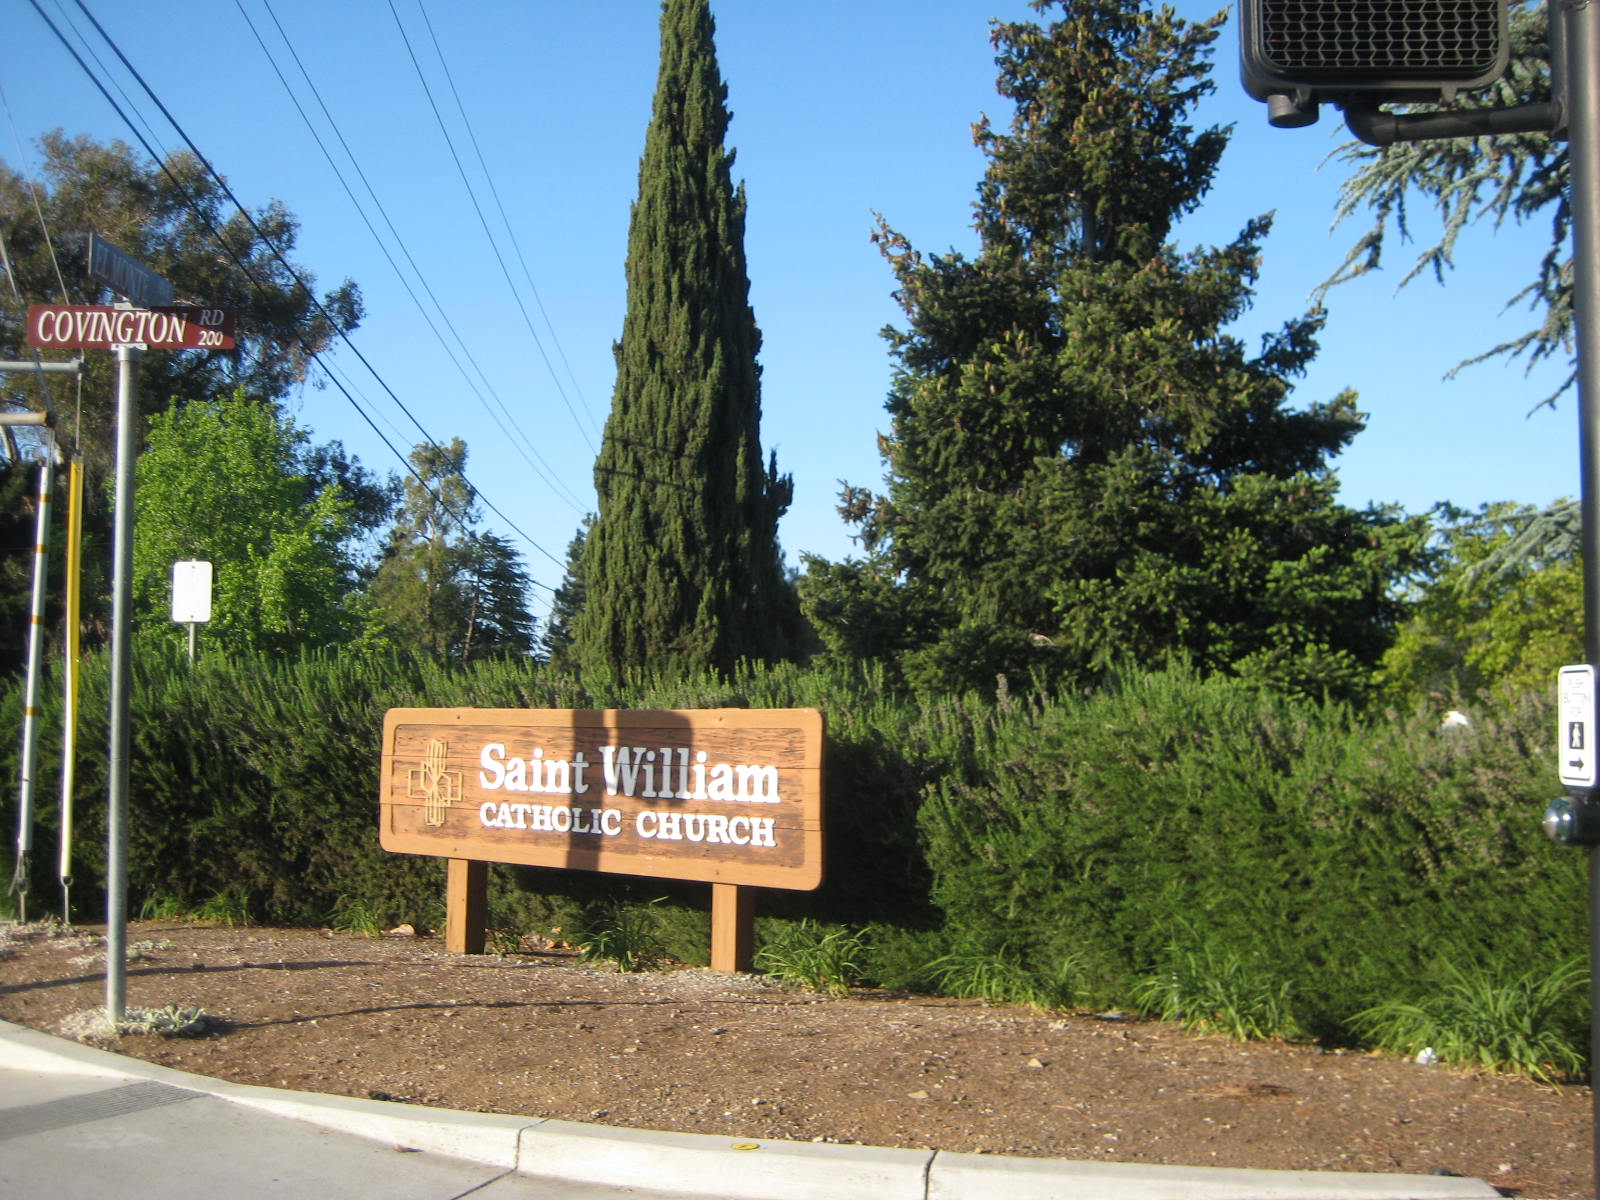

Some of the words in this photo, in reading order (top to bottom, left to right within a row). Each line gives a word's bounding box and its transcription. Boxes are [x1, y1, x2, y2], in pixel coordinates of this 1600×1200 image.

[37, 310, 187, 343] COVINGTON
[200, 309, 224, 326] RD
[197, 330, 223, 346] 200
[479, 743, 589, 794] Saint
[599, 745, 781, 803] William
[479, 802, 623, 836] CATHOLIC
[636, 811, 777, 847] CHURCH
